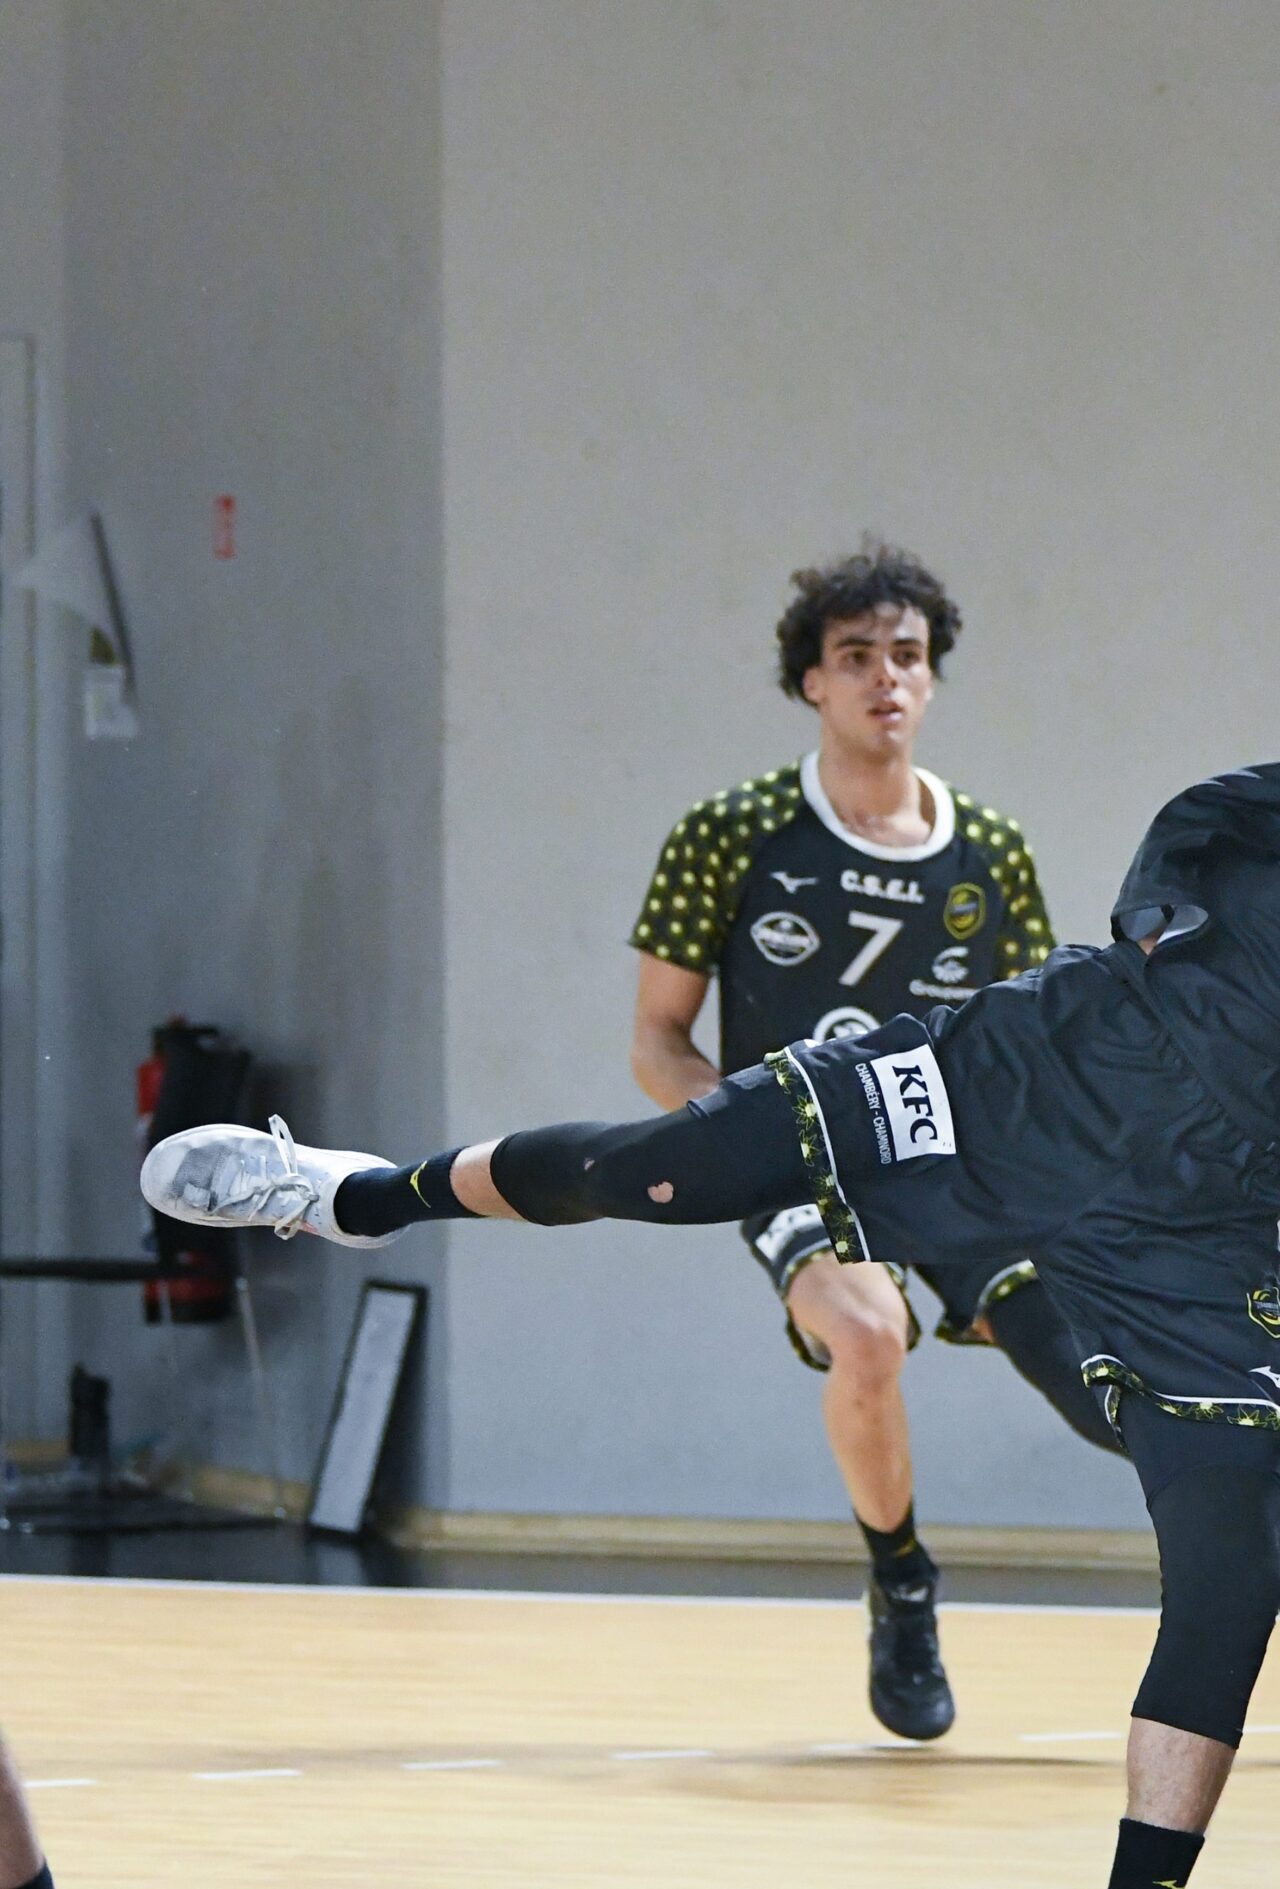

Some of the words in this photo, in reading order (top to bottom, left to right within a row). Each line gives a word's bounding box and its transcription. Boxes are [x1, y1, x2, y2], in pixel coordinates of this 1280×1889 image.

[838, 910, 904, 986] 7
[855, 1062, 881, 1110] CHAMBÉRY
[873, 1116, 892, 1165] CHAMNORD
[892, 1065, 938, 1144] KFC
